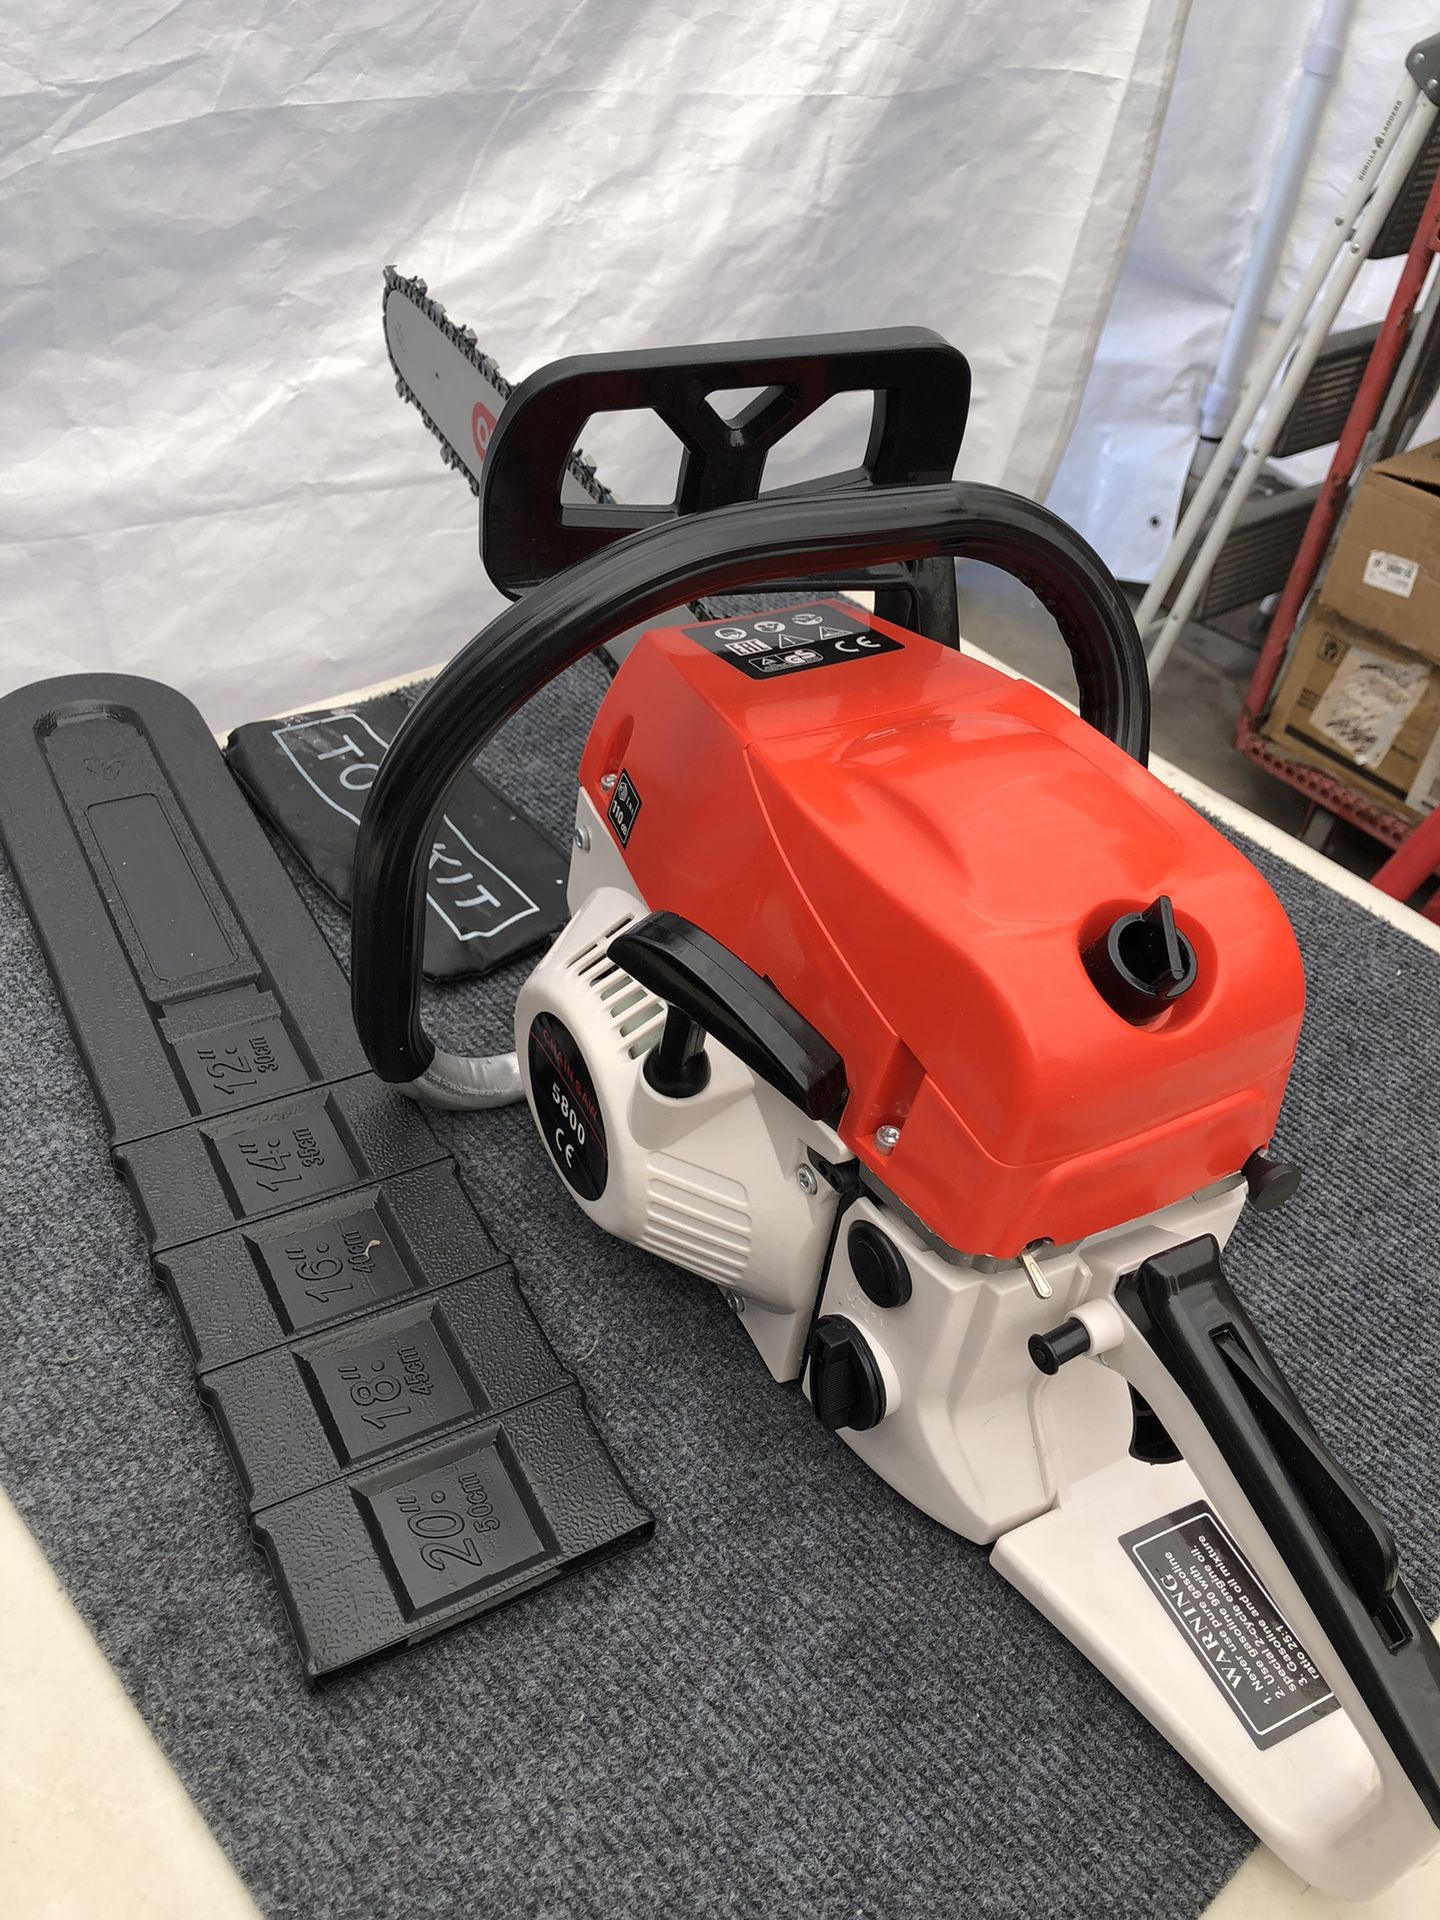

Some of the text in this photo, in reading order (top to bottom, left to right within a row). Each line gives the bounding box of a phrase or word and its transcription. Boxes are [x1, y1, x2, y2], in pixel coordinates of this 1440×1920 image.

[1381, 100, 1402, 136] LADDERS
[785, 650, 817, 664] GS
[835, 636, 881, 652] CE
[318, 735, 501, 907] TO KIT
[612, 800, 624, 824] 110
[249, 1036, 279, 1073] 30cm
[552, 1082, 585, 1145] 5800
[292, 1128, 325, 1167] 35cm
[555, 1128, 575, 1168] CE
[342, 1230, 375, 1273] 40cm
[398, 1346, 434, 1395] 45cm
[458, 1472, 500, 1533] 50cm
[1160, 1574, 1242, 1689] WARNING
[1164, 1552, 1272, 1705] 1. Never use pure gasoline
[1189, 1565, 1285, 1699] 2. Use gasoline 90 with
[1191, 1545, 1296, 1692] special 2-cycle engine oil.
[1198, 1535, 1308, 1686] 3. Gasoline and oil mixture
[1275, 1625, 1319, 1680] ratio 25:1
